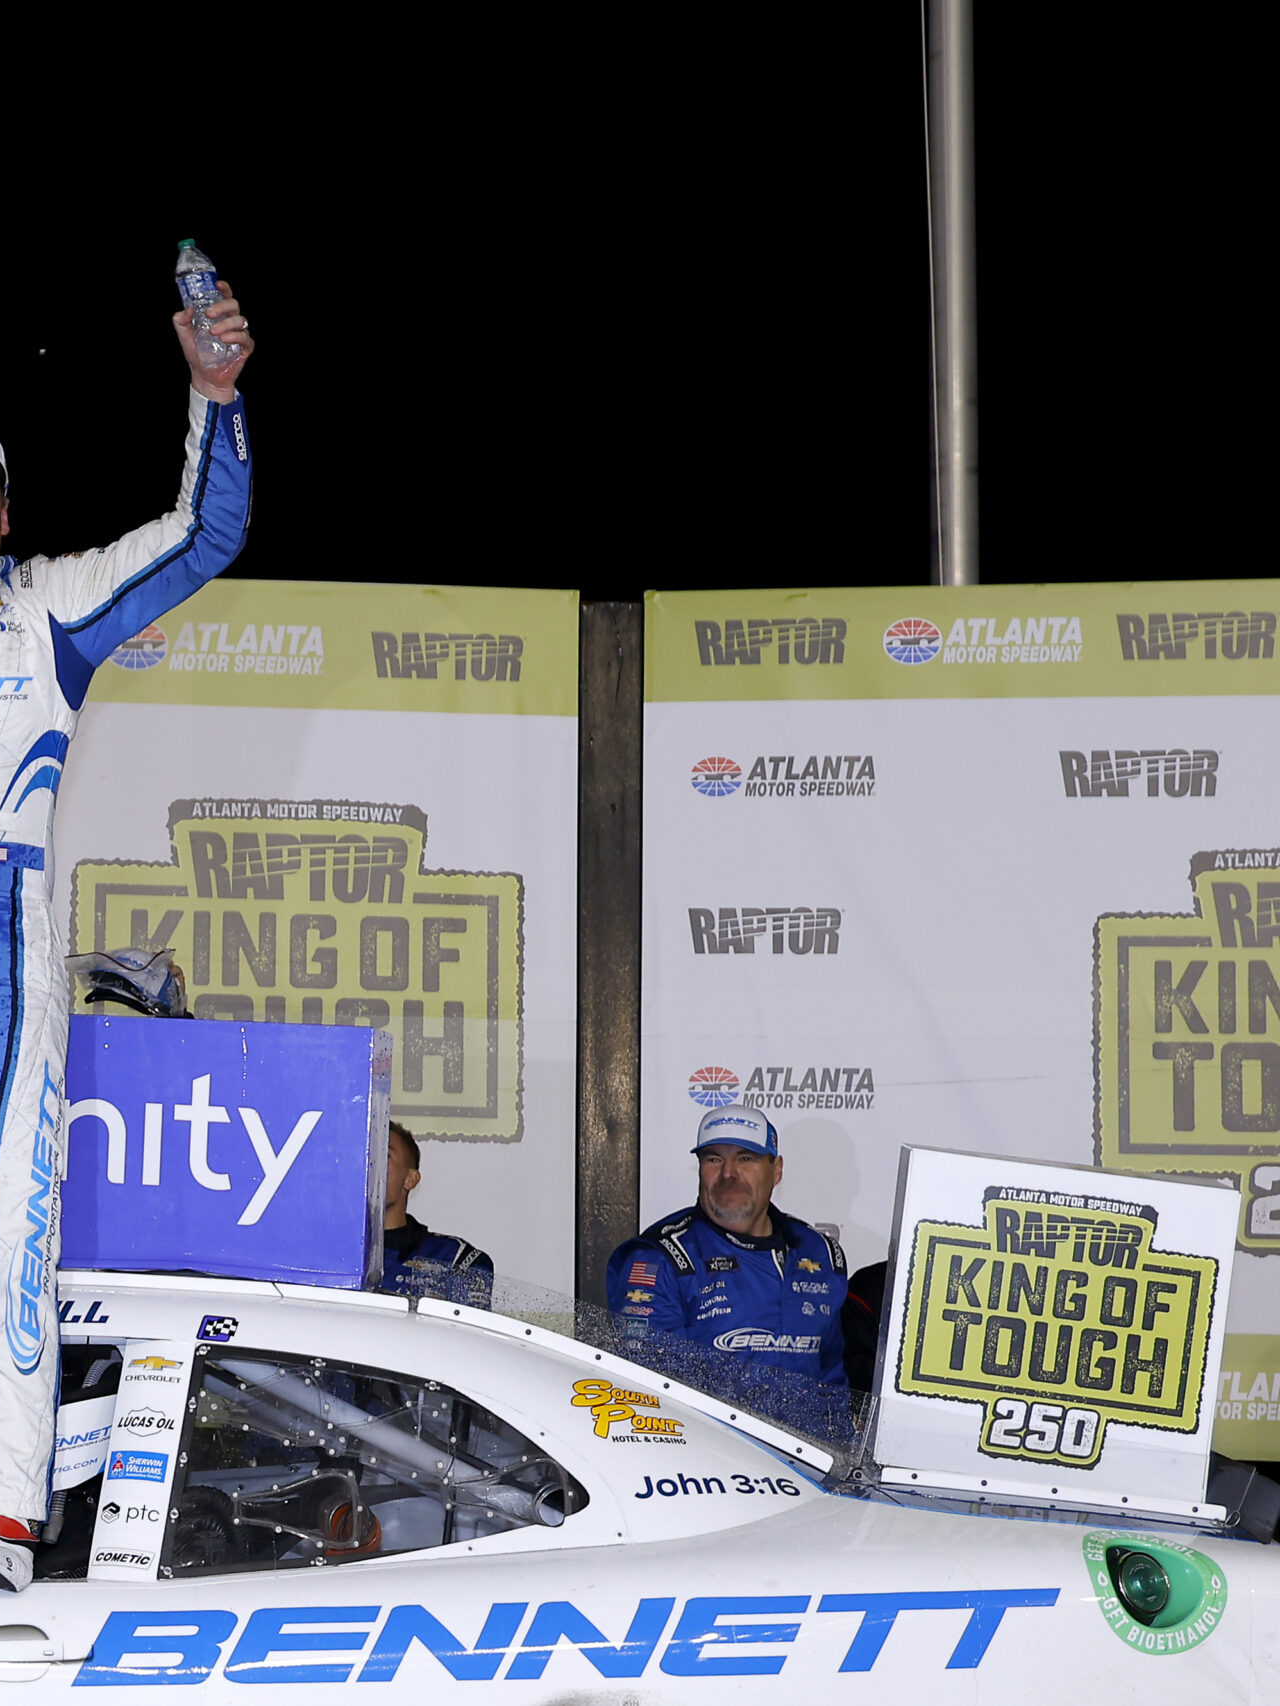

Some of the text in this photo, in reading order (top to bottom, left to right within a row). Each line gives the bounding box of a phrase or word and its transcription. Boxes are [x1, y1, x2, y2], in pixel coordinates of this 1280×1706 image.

[173, 622, 324, 656] ATLANTA
[695, 618, 847, 665] RAPTOR
[944, 617, 1082, 647] ATLANTA
[1116, 611, 1277, 660] RAPTOR
[169, 653, 324, 675] MOTOR SPEEDWAY
[371, 631, 524, 682] RAPTOR
[943, 645, 1082, 663] MOTOR SPEEDWAY
[748, 755, 875, 780] ATLANTA
[1060, 749, 1220, 798] RAPTOR
[745, 780, 875, 797] MOTOR SPEEDWAY
[192, 803, 403, 822] ATLANTA MOTOR SPEEDWAY
[189, 831, 408, 903] RAPTOR
[688, 907, 843, 954] RAPTOR
[359, 915, 467, 992] OF
[745, 1067, 874, 1093] ATLANTA
[742, 1094, 874, 1110] MOTOR SPEEDWAY
[61, 1073, 323, 1226] nity
[19, 1058, 60, 1342] BENNETT
[999, 1189, 1142, 1216] ATLANTA MOTOR SPEEDWAY
[996, 1207, 1143, 1269] RAPTOR
[946, 1255, 1177, 1331] KING OF
[942, 1309, 1168, 1398] TOUGH
[125, 1374, 181, 1384] CHEVROLET
[117, 1416, 175, 1430] LUCAS OIL
[986, 1397, 1100, 1459] 250
[611, 1435, 641, 1444] HOTEL
[653, 1436, 686, 1446] CASINO
[127, 1456, 163, 1468] SHERWIN
[635, 1473, 802, 1499] John 3:16
[126, 1503, 160, 1523] ptc
[95, 1551, 151, 1565] COMETIC
[1103, 1597, 1129, 1629] GET
[71, 1587, 1061, 1686] BENNETT
